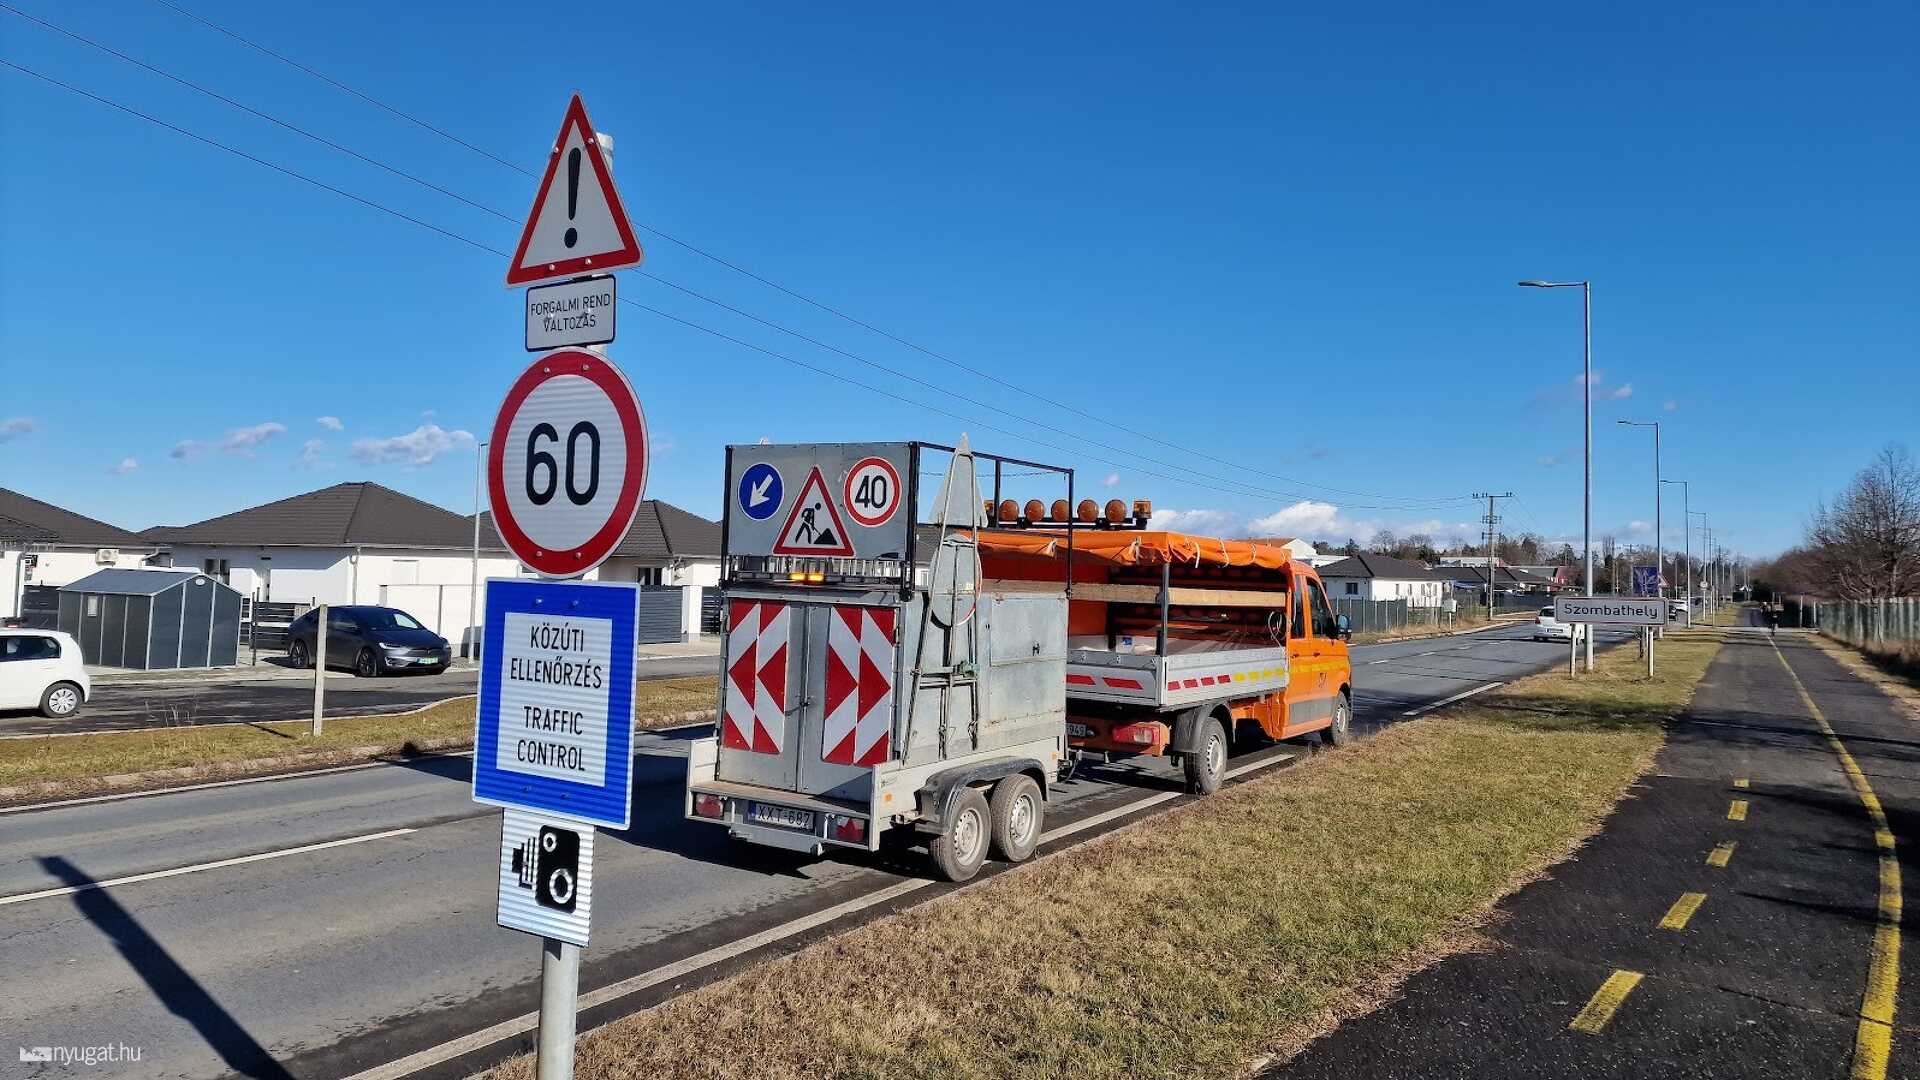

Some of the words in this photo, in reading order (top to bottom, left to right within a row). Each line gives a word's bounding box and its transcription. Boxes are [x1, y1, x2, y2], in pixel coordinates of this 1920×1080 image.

[530, 297, 579, 316] FORGALMI
[582, 293, 610, 309] REND
[526, 421, 600, 506] 60
[855, 475, 887, 508] 40
[1564, 604, 1658, 619] Szombathely
[530, 622, 584, 652] KÖZÚTI
[510, 655, 602, 689] ELLENŐRZÉS
[523, 706, 583, 735] TRAFFIC
[517, 739, 586, 771] CONTROL
